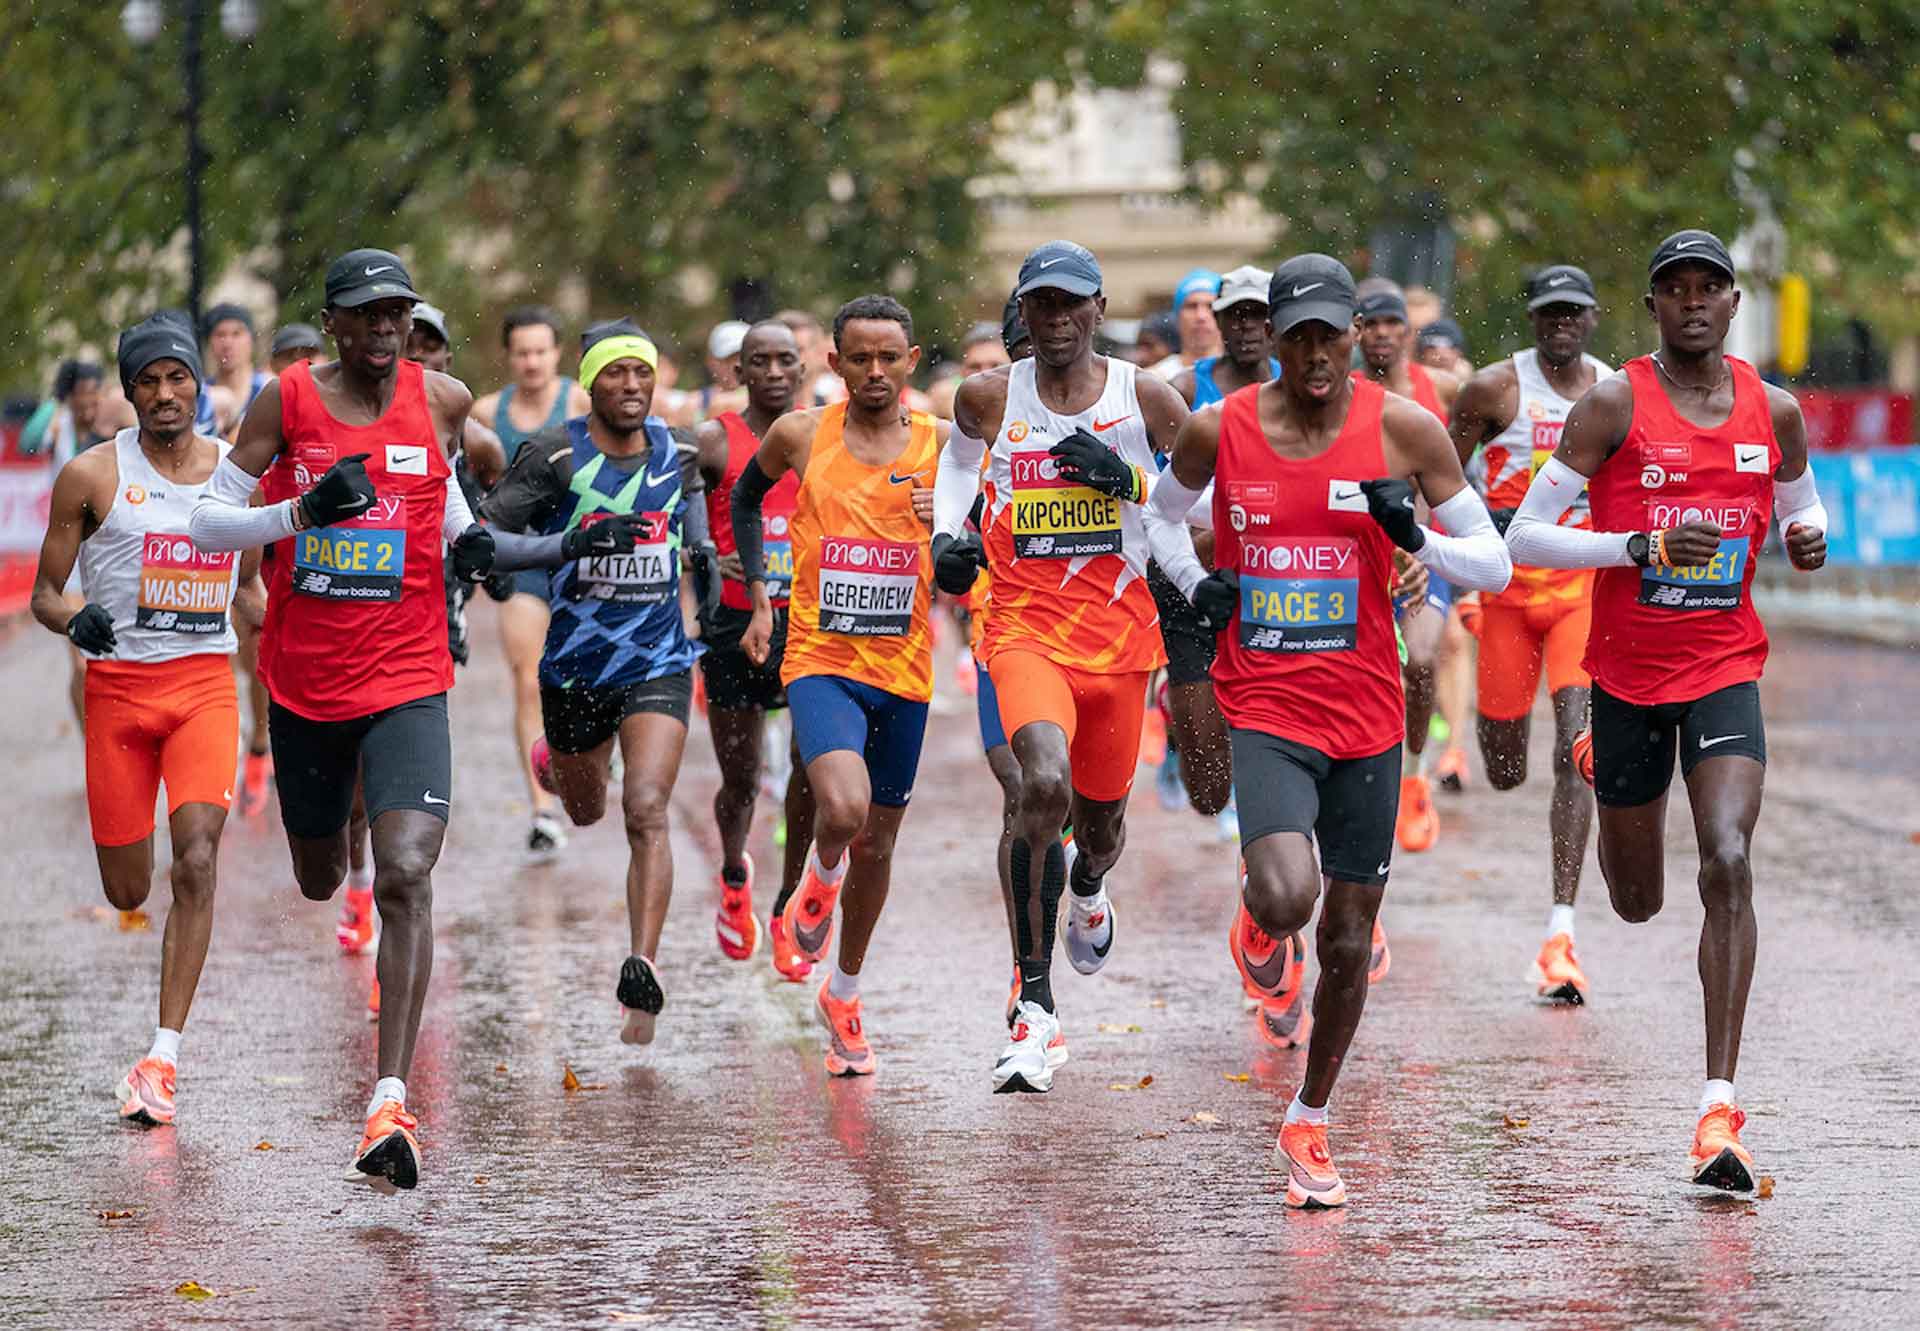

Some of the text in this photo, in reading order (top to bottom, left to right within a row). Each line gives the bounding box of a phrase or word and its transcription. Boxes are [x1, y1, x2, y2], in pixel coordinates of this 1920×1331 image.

[1669, 473, 1688, 482] NN
[1017, 498, 1116, 528] KIPCHOGE
[1251, 514, 1270, 525] NN
[304, 535, 393, 571] PACE 2
[825, 542, 916, 569] MONEY
[1055, 545, 1074, 554] new
[1075, 543, 1113, 553] balance
[1244, 544, 1352, 571] MONEY
[590, 556, 663, 578] KITATA
[1729, 552, 1738, 579] 1
[144, 577, 227, 608] WASIHUN
[329, 587, 350, 596] new
[350, 586, 391, 597] balance
[824, 581, 913, 610] GEREMEW
[1685, 599, 1703, 607] new
[1251, 590, 1344, 622] PACE 3
[872, 625, 903, 634] balance
[1283, 641, 1305, 649] new
[1306, 638, 1346, 649] balance
